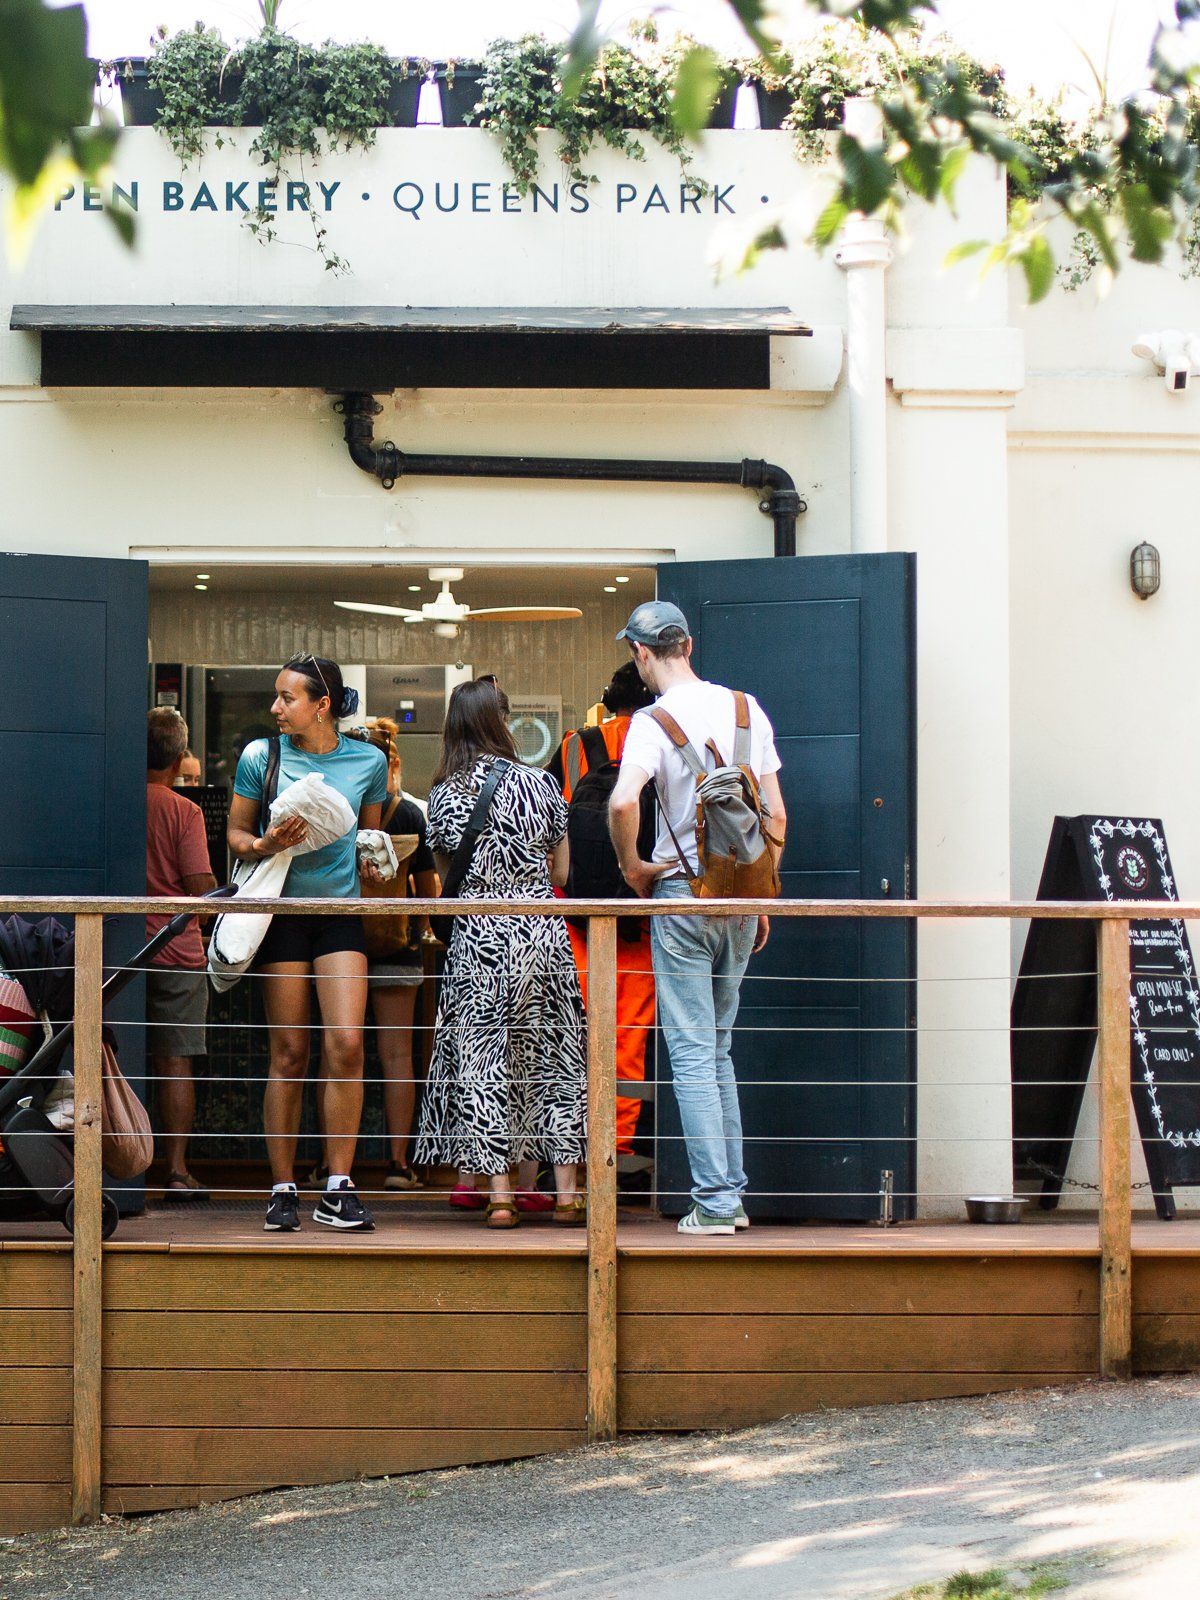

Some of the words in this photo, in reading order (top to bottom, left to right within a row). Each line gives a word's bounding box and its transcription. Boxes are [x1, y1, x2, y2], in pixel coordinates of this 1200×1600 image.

[53, 181, 139, 212] PEN
[162, 181, 342, 212] BAKERY
[392, 181, 591, 220] QUEENS
[616, 182, 737, 214] PARK
[1136, 981, 1156, 997] OPEN
[1156, 980, 1183, 997] MON-SAT
[1153, 1048, 1171, 1062] CARD
